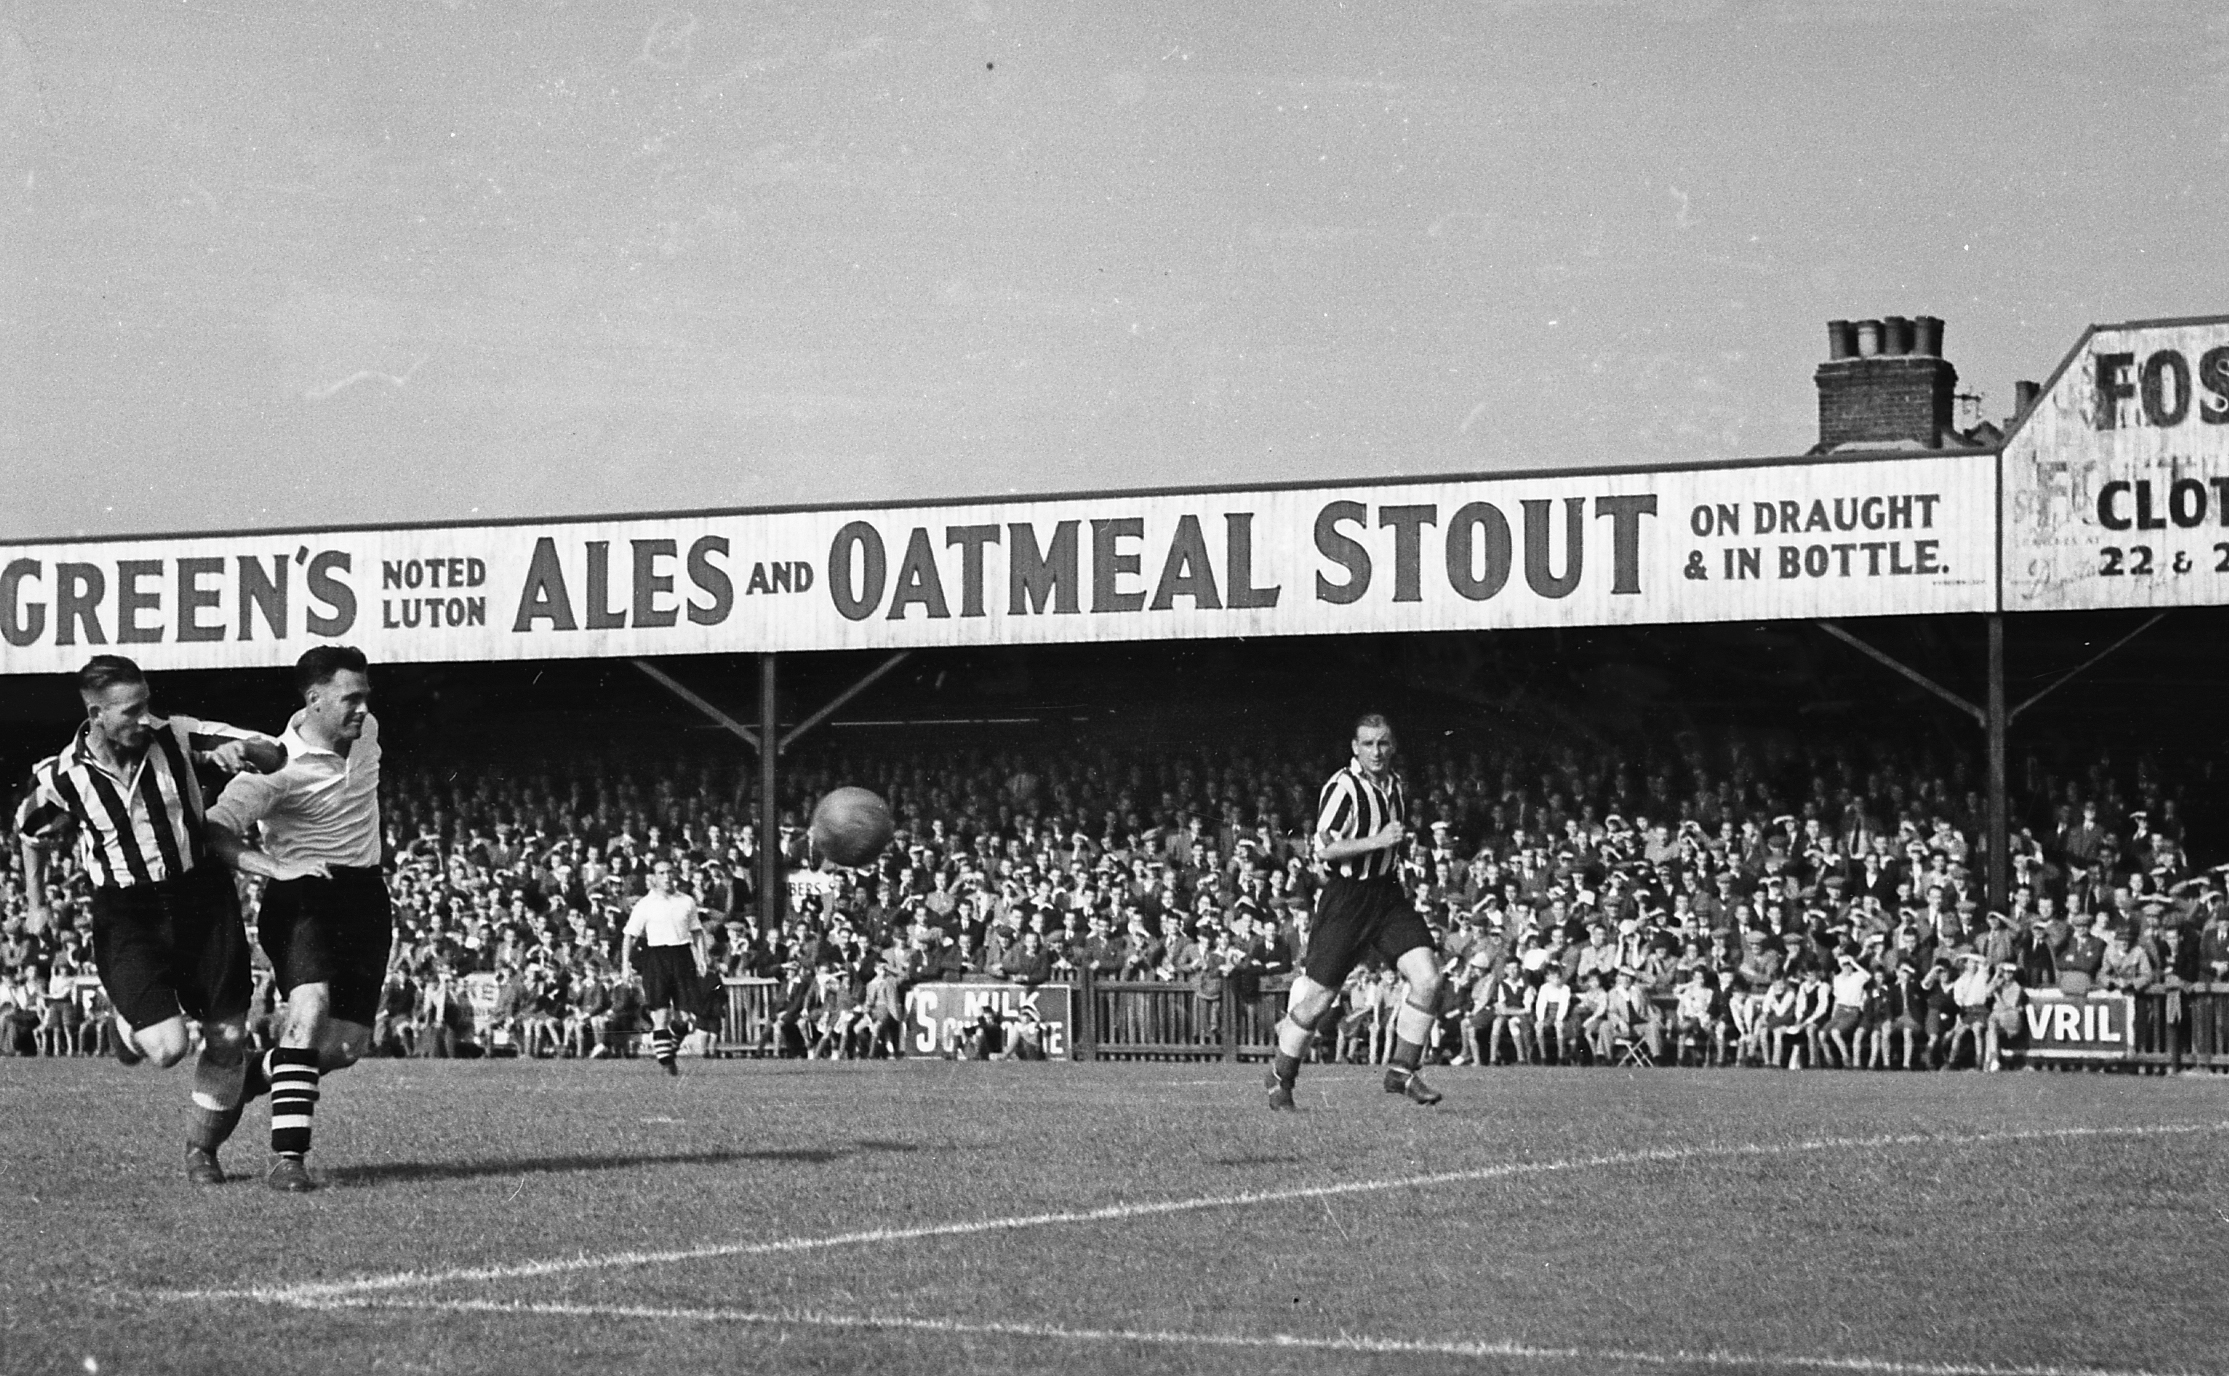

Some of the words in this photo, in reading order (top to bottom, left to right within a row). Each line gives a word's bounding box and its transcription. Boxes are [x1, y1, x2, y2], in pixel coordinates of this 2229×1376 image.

[1690, 504, 1740, 537] ON
[1754, 494, 1941, 535] DRAUGHT
[382, 557, 486, 590] NOTED
[511, 536, 734, 633] ALES
[745, 561, 814, 596] AND
[828, 512, 1282, 622] OATMEAL
[1313, 494, 1658, 605] STOUT
[1683, 550, 1709, 581] &
[1723, 547, 1761, 580] IN
[1778, 539, 1951, 578] BOTTLE.
[2099, 546, 2154, 577] 22
[2172, 551, 2193, 574] &
[0, 545, 359, 647] GREEN'S
[382, 596, 486, 629] LUTON
[964, 991, 1041, 1018] MILK
[2025, 1003, 2121, 1042] VRIL
